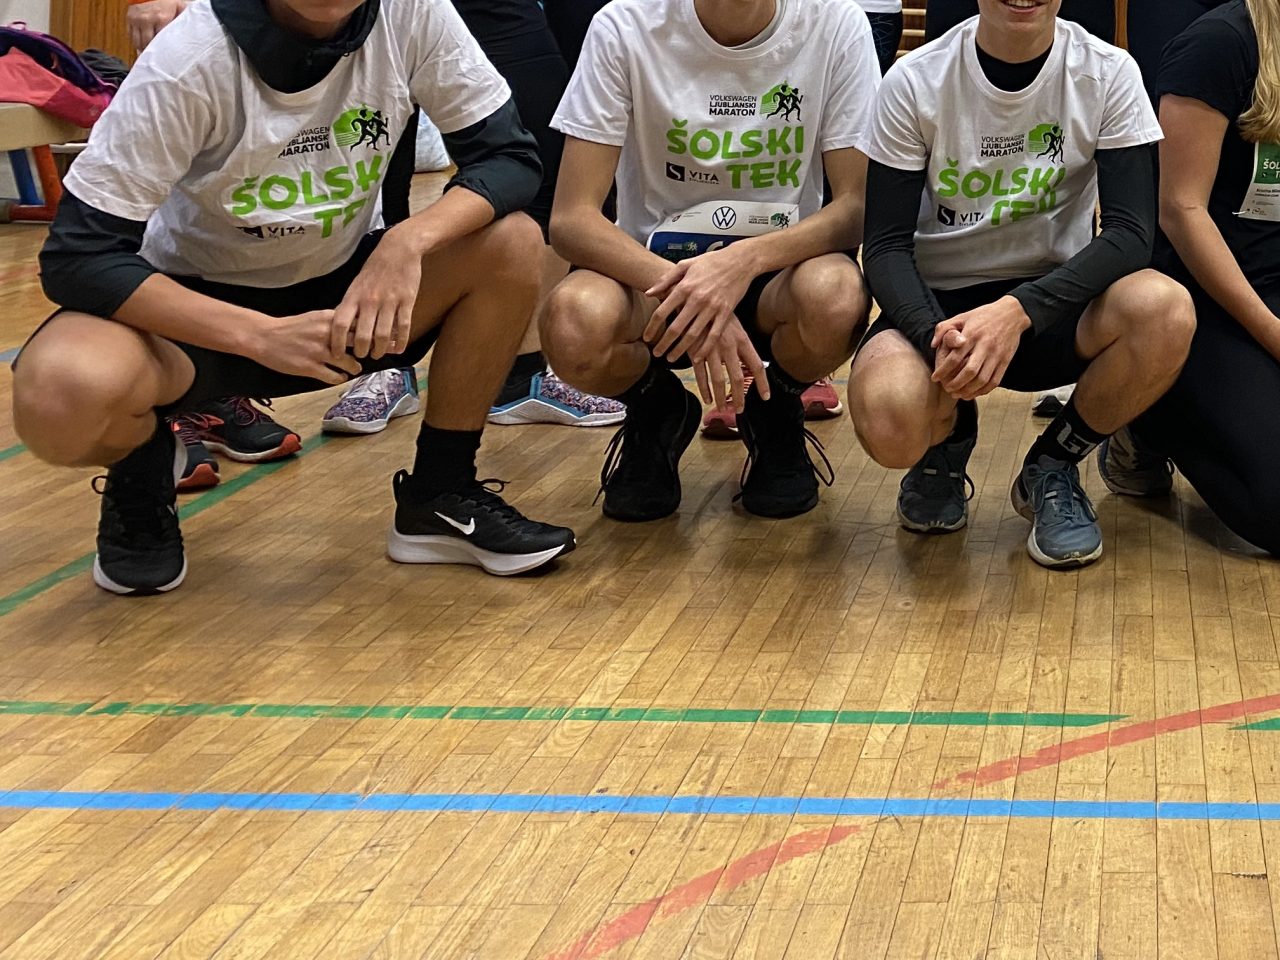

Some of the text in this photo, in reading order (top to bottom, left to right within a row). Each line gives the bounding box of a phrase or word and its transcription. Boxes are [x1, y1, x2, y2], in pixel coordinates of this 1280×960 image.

[709, 94, 757, 103] VOLKSWAGEN
[709, 108, 756, 116] MARATON
[666, 118, 804, 160] ŠOLSKI
[981, 133, 1025, 143] VOLKSWAGEN
[981, 140, 1024, 149] LJUBLJANSKI
[980, 145, 1024, 158] MARATON
[689, 170, 719, 182] VITA
[726, 159, 802, 189] TEK
[937, 157, 1067, 199] ŠOLSKI
[231, 153, 384, 216] ŠOLSK
[314, 198, 367, 238] TE
[267, 226, 305, 238] VITA
